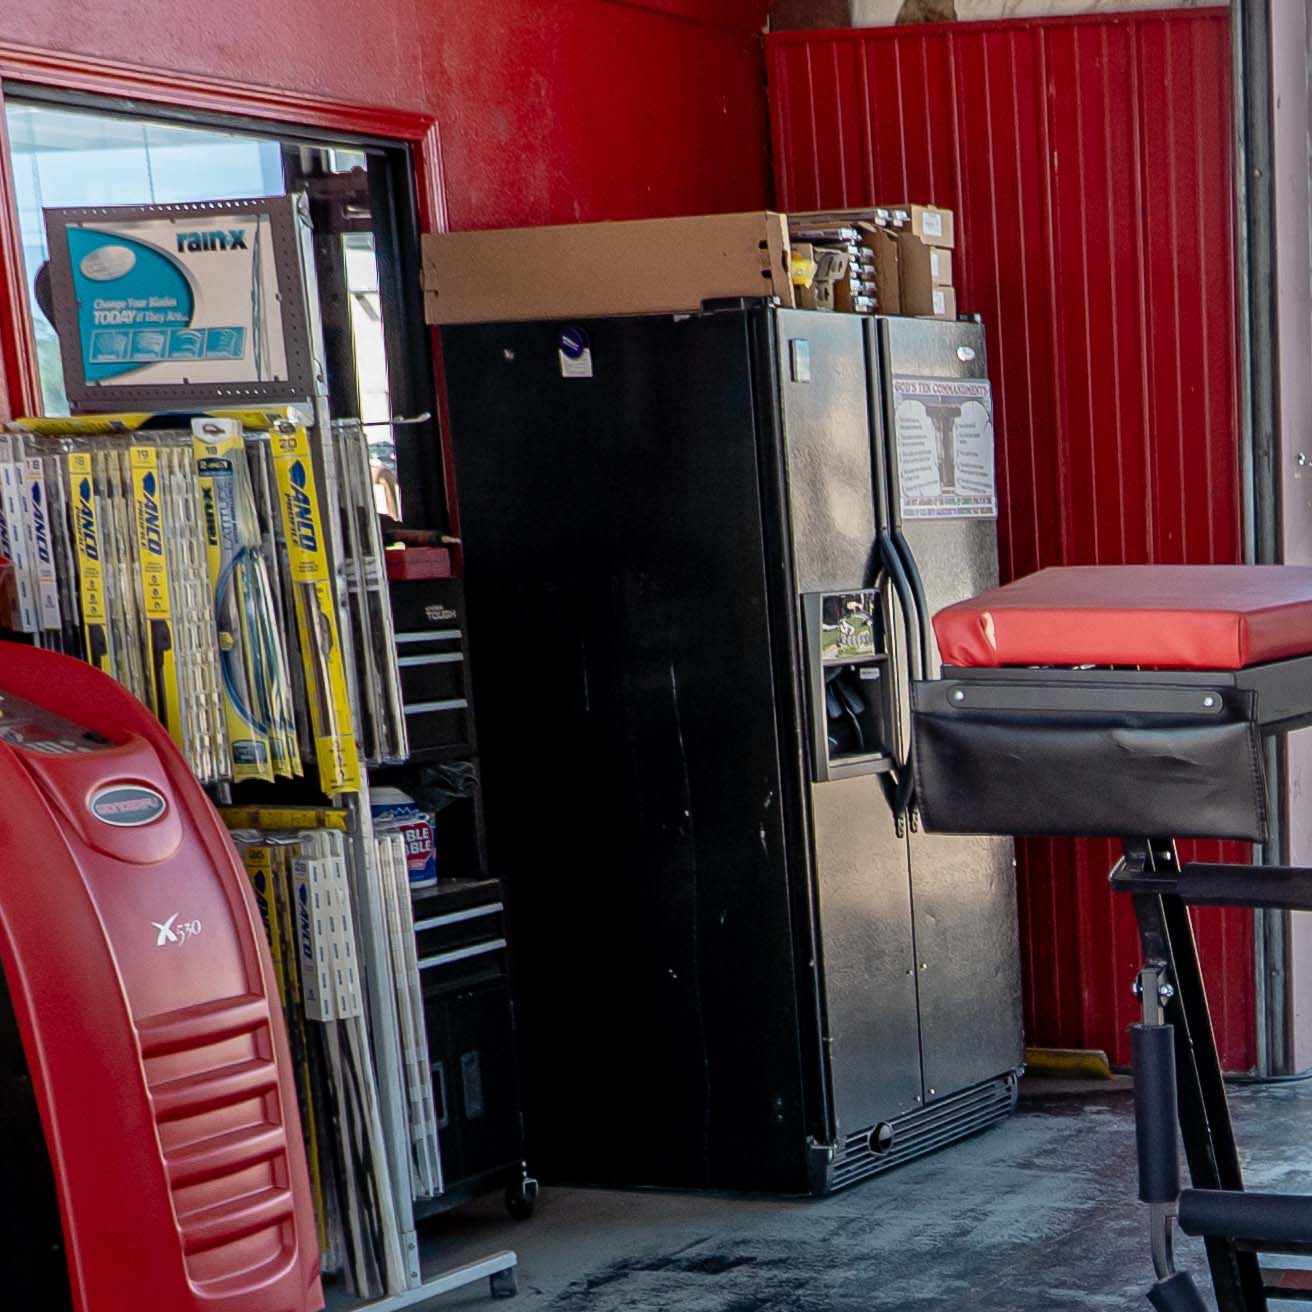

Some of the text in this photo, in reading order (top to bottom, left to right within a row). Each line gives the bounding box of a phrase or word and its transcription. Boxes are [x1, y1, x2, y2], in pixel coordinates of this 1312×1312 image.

[94, 310, 136, 325] TODAY
[137, 450, 149, 460] 19
[279, 438, 297, 449] 20
[33, 502, 50, 564] ANCO
[80, 499, 99, 561] ANCO
[143, 492, 162, 556] ANCO
[290, 484, 317, 552] ANCO
[406, 827, 430, 842] BLE
[298, 901, 314, 960] ANCO
